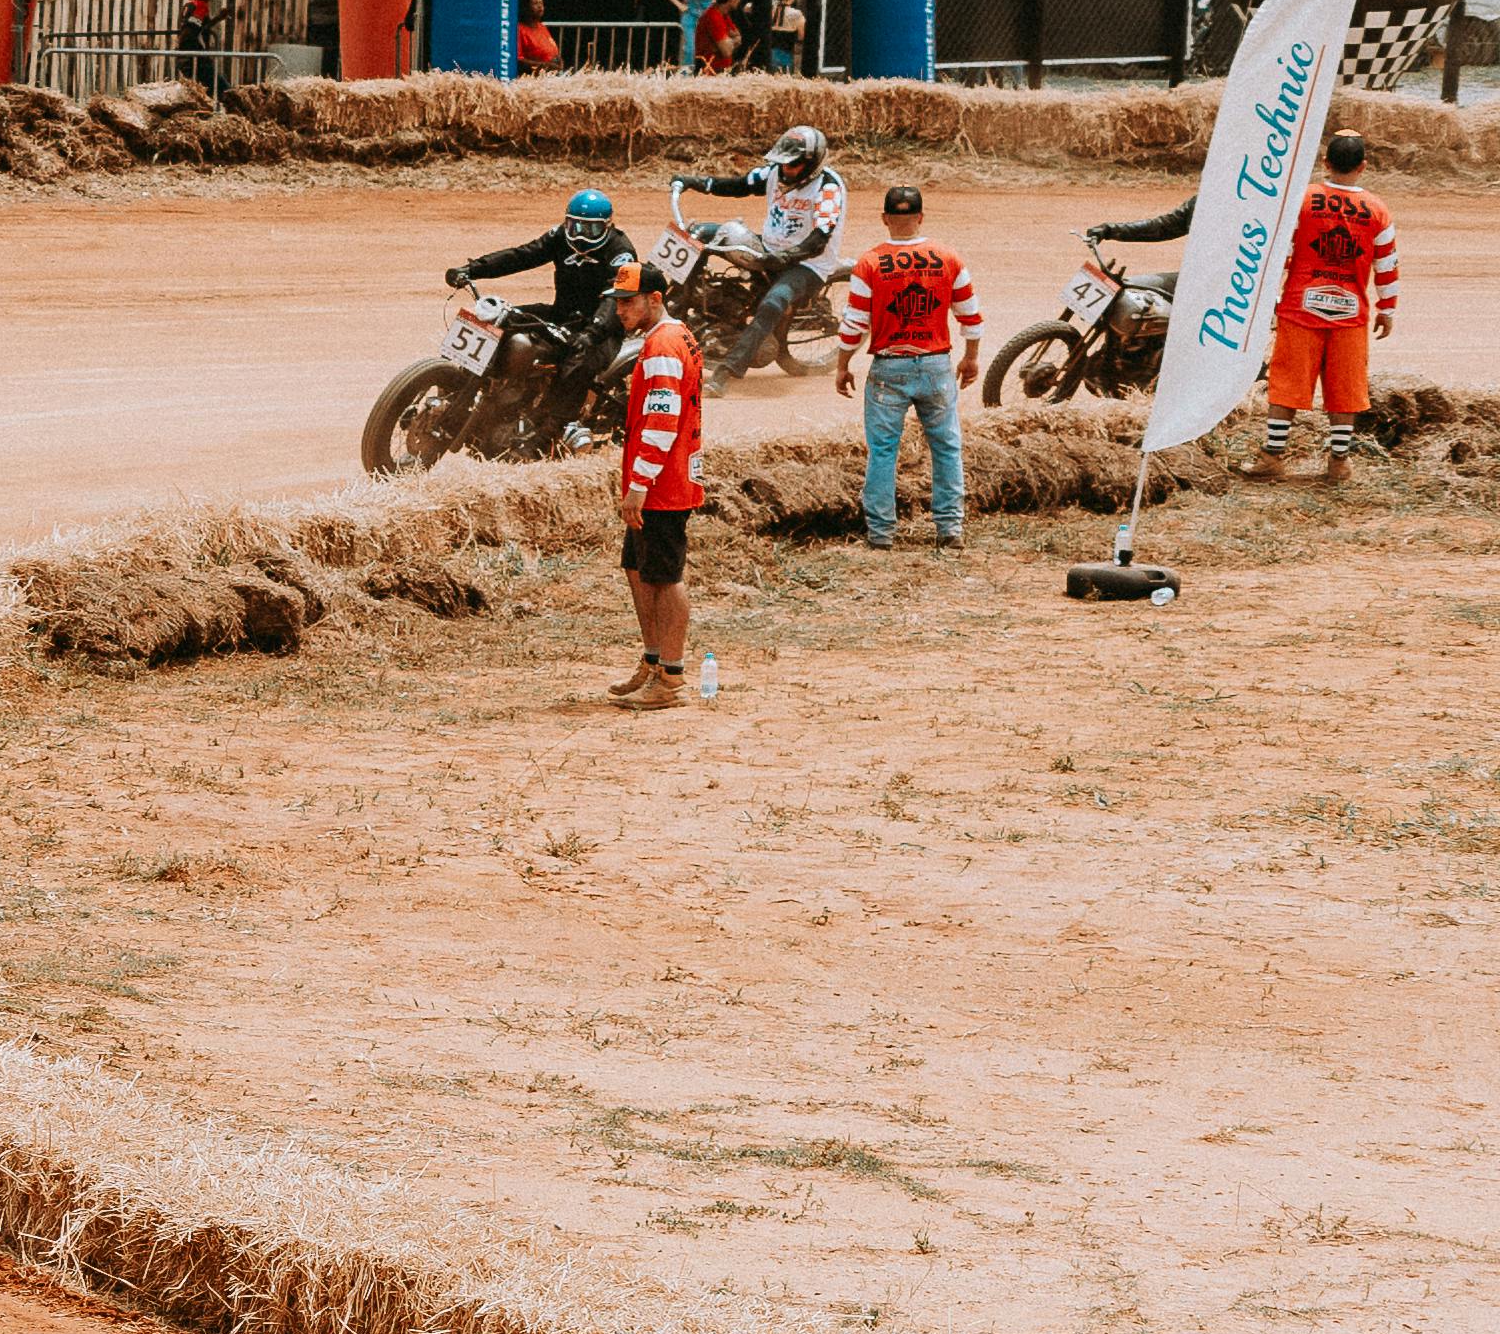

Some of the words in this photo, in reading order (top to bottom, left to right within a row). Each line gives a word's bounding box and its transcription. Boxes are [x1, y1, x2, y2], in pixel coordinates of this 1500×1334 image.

[1199, 217, 1269, 351] Pneus
[1236, 40, 1315, 201] Technic
[1311, 193, 1373, 220] BOSS
[656, 238, 690, 269] 59
[878, 250, 944, 274] BOSS
[1073, 282, 1107, 308] 47
[450, 326, 487, 362] 51
